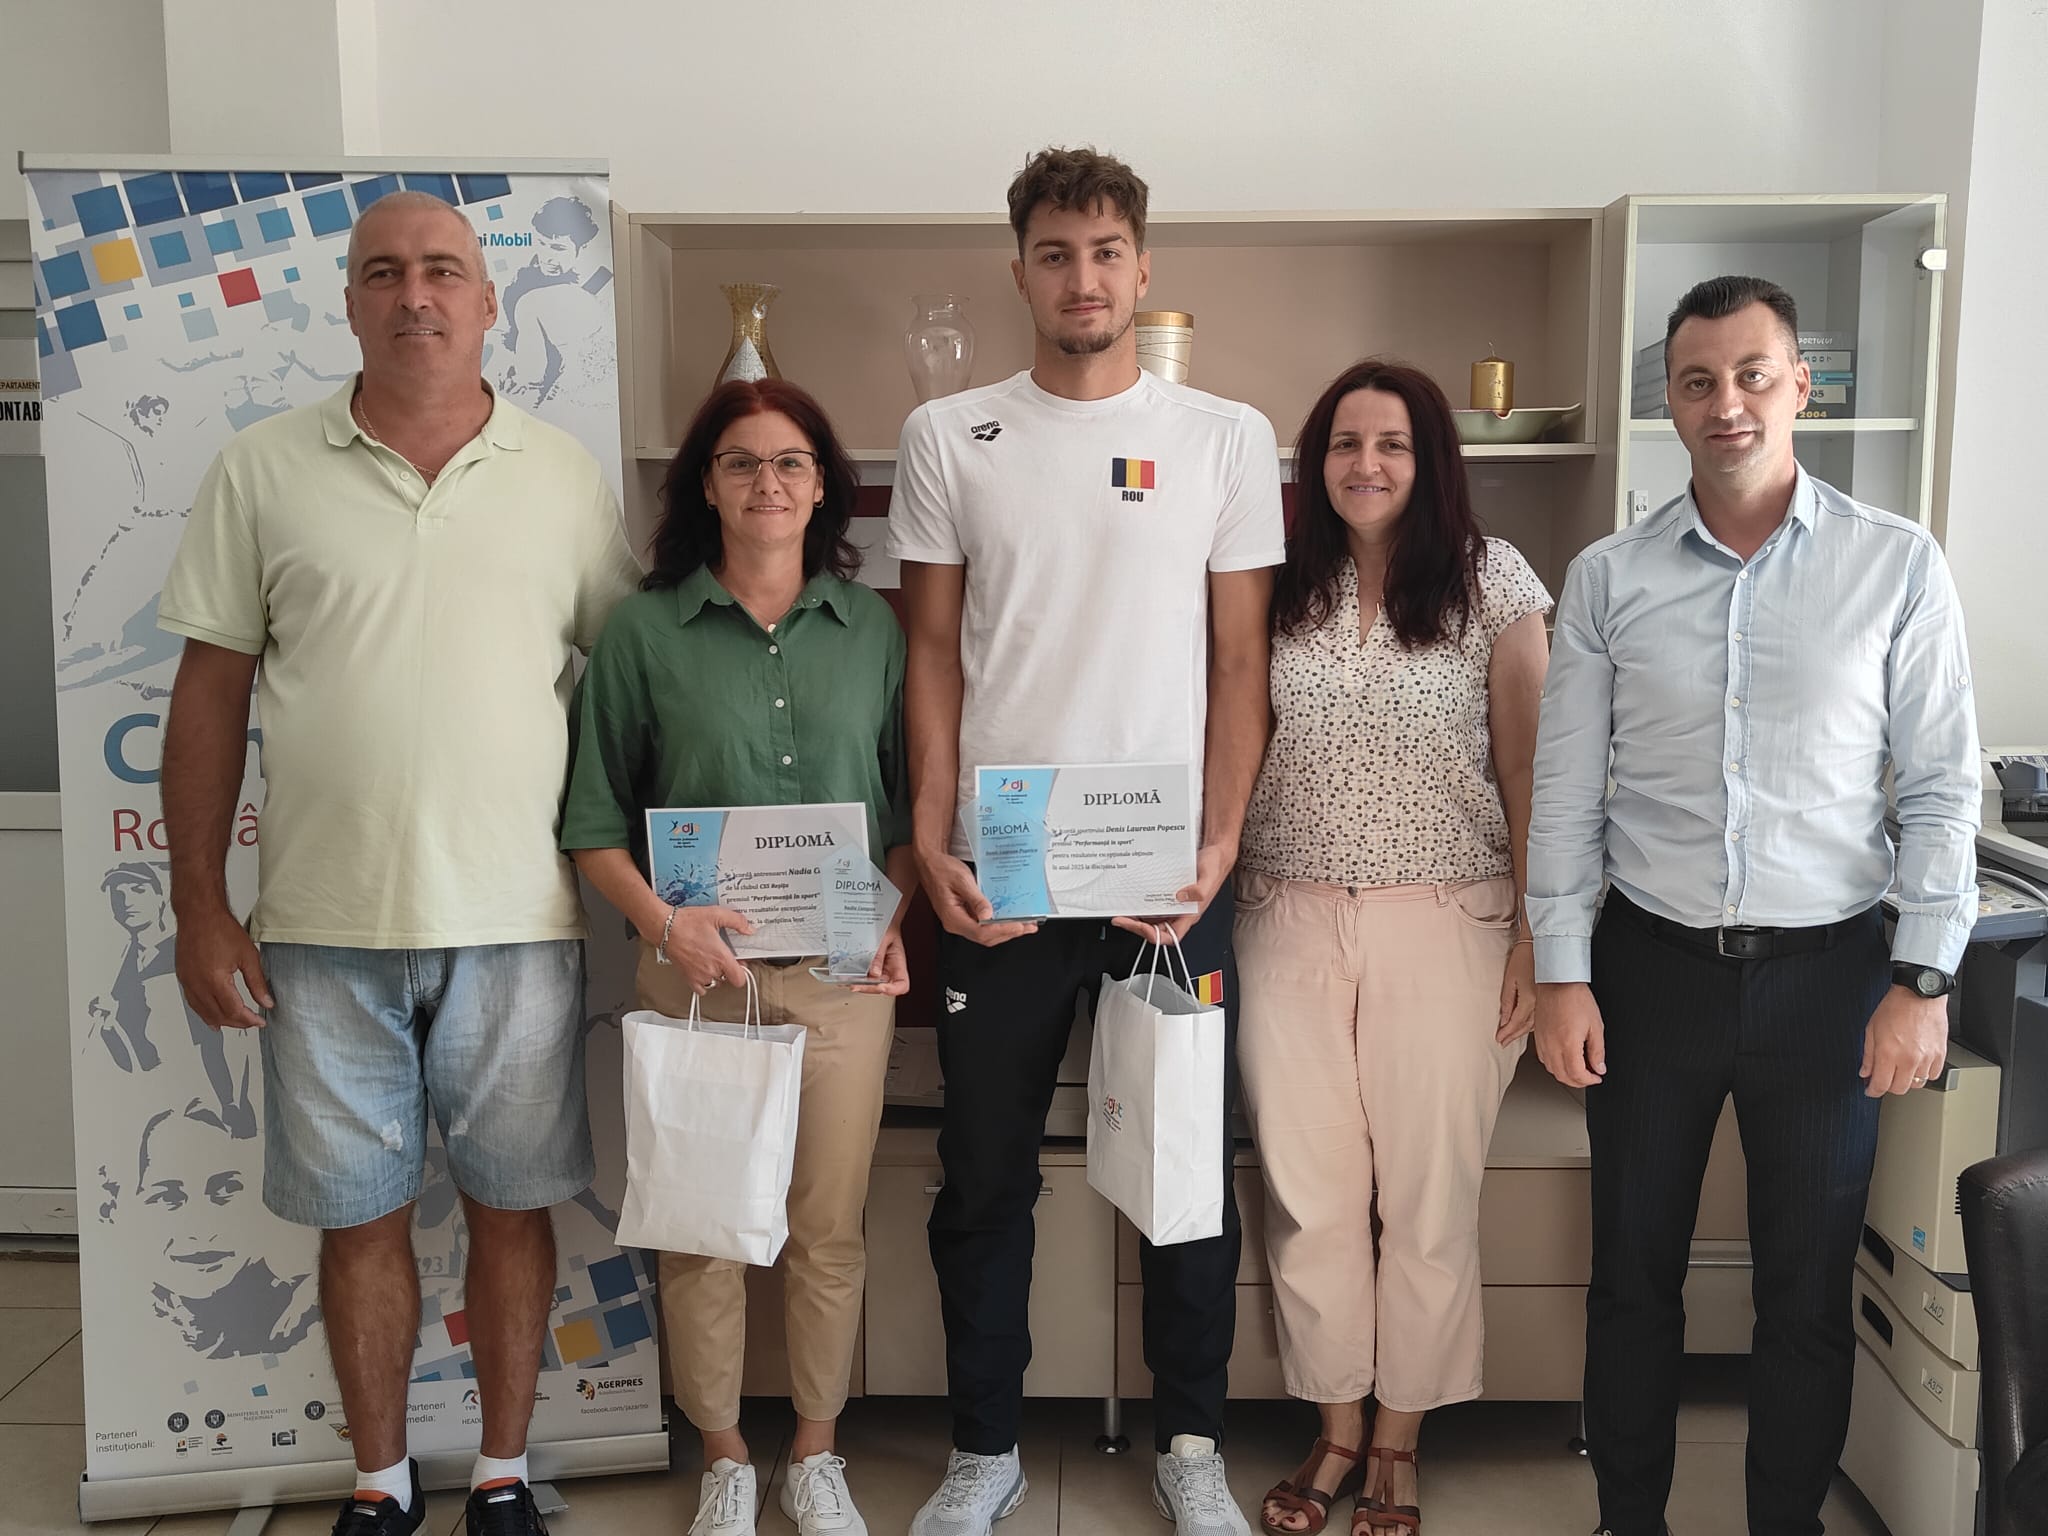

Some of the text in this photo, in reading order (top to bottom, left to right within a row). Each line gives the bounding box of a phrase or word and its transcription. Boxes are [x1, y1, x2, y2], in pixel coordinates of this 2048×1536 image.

[490, 232, 532, 247] Mobil
[1799, 337, 1833, 345] PORTULUI
[1810, 389, 1825, 398] 05
[970, 420, 1000, 434] arena
[1121, 490, 1144, 502] ROU
[1083, 789, 1162, 806] DIPLOMĂ
[981, 822, 1031, 836] DIPLOMĂ
[1105, 825, 1125, 833] Denis
[1157, 824, 1186, 833] Popescu
[755, 831, 836, 849] DIPLOMĂ
[788, 866, 813, 876] Nadia
[835, 880, 882, 892] DIPLOMĂ
[597, 1378, 644, 1390] AGERPRES
[405, 1401, 446, 1412] Parteneri
[95, 1430, 138, 1441] Parteneri
